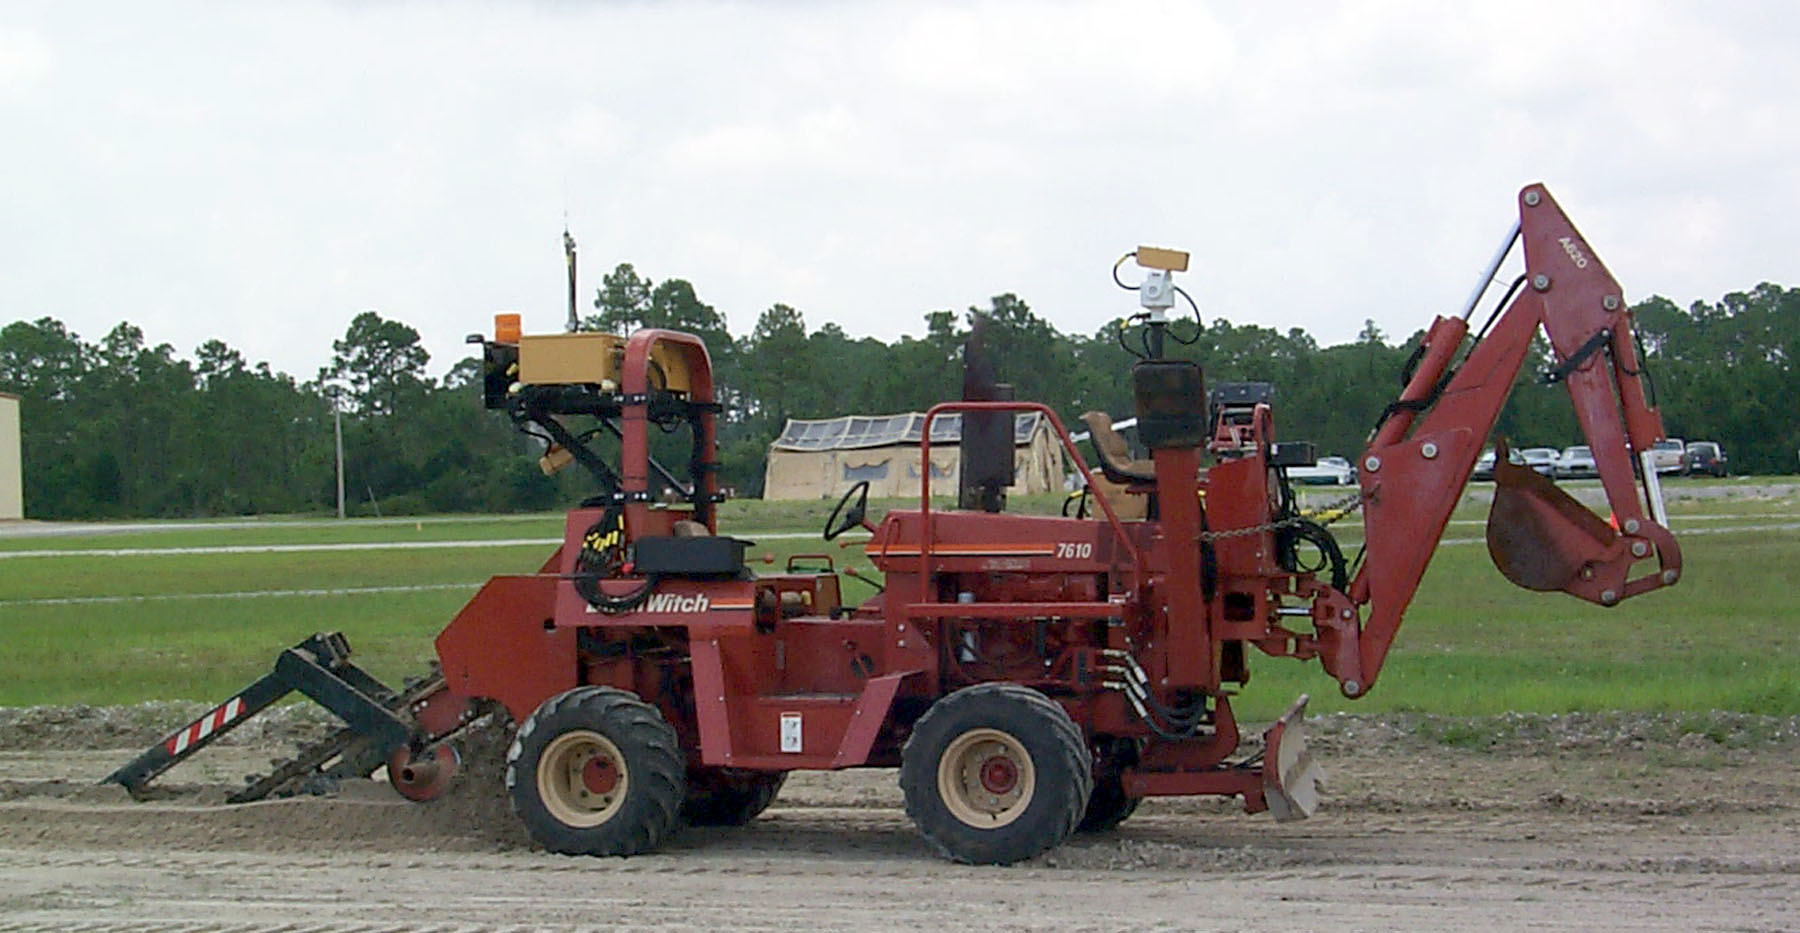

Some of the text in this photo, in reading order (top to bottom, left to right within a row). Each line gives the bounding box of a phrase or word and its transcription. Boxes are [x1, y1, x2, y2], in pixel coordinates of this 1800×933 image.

[1558, 237, 1588, 268] A620
[1057, 543, 1092, 558] 7610
[647, 593, 710, 613] Witch
